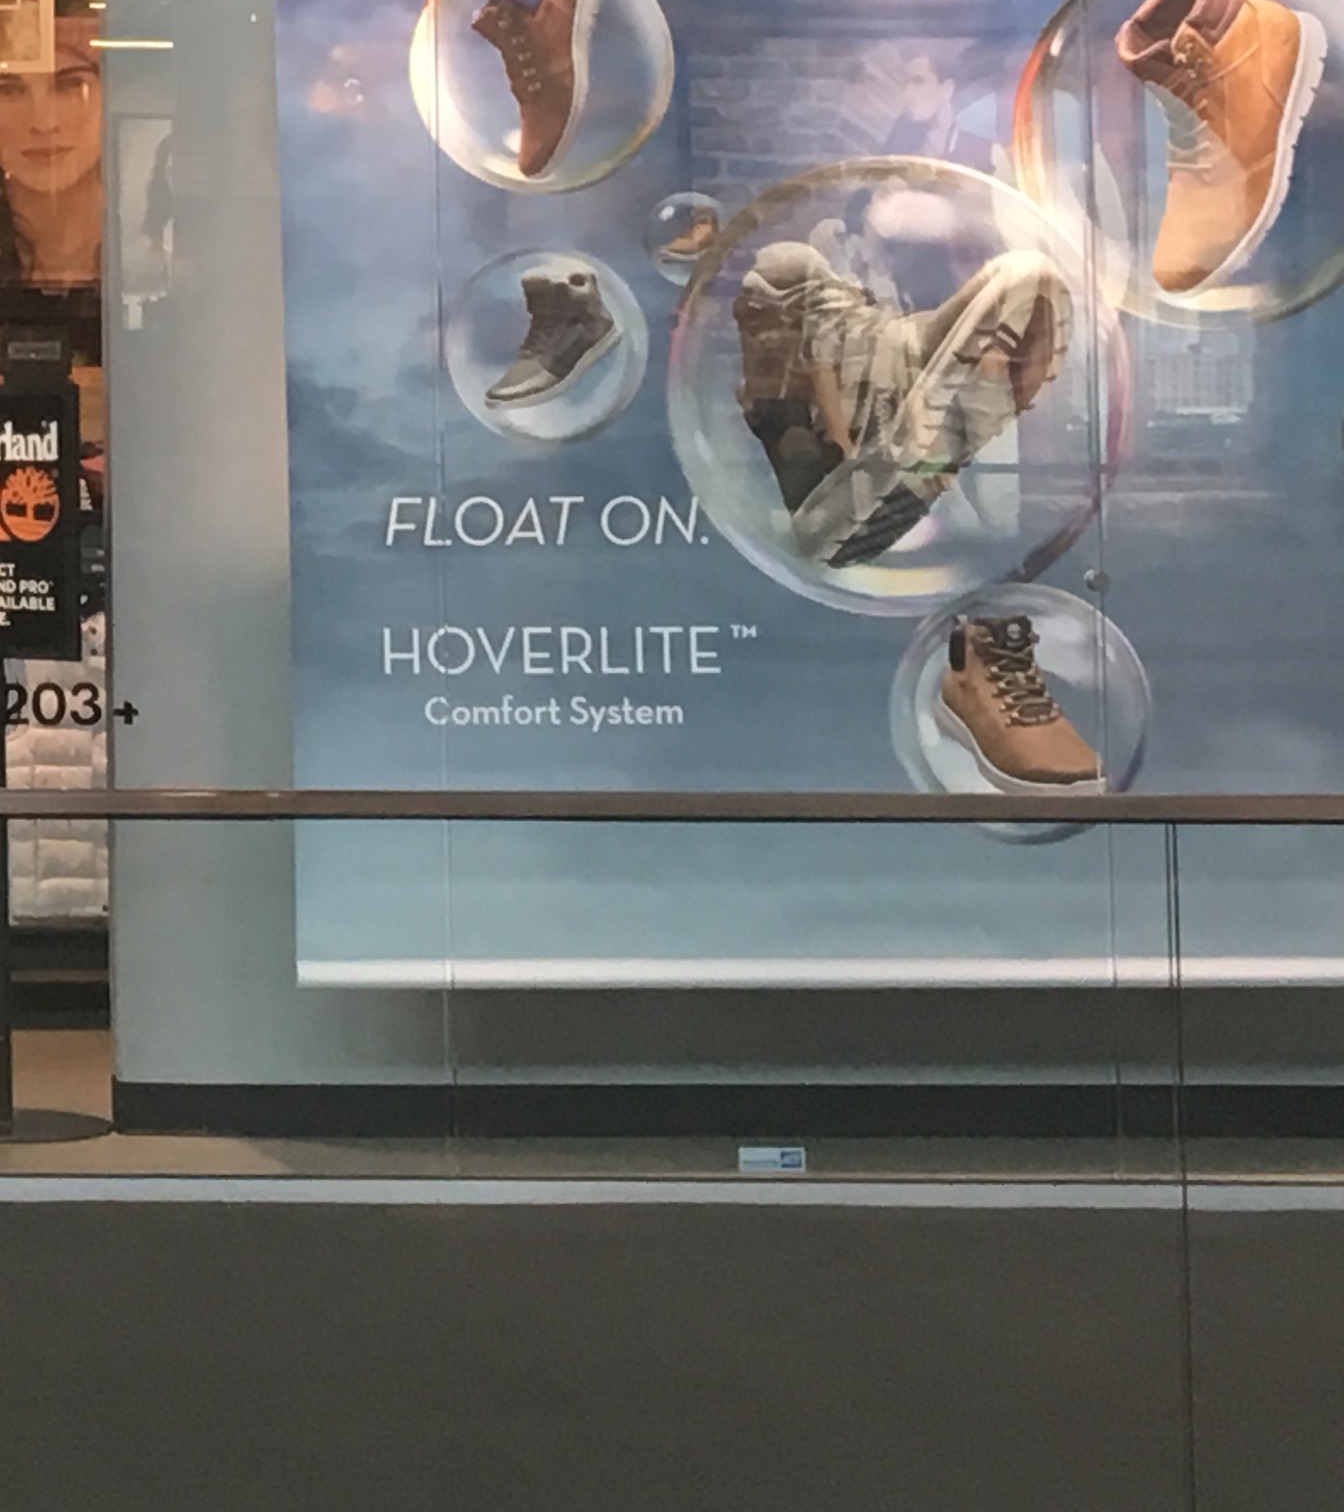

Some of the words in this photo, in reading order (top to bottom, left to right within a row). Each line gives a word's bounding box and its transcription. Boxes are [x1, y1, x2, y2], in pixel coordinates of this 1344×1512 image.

[386, 496, 585, 547] FLOAT
[600, 495, 709, 547] ON.
[2, 681, 102, 726] 203
[424, 695, 561, 725] Comfort
[569, 696, 684, 732] System
